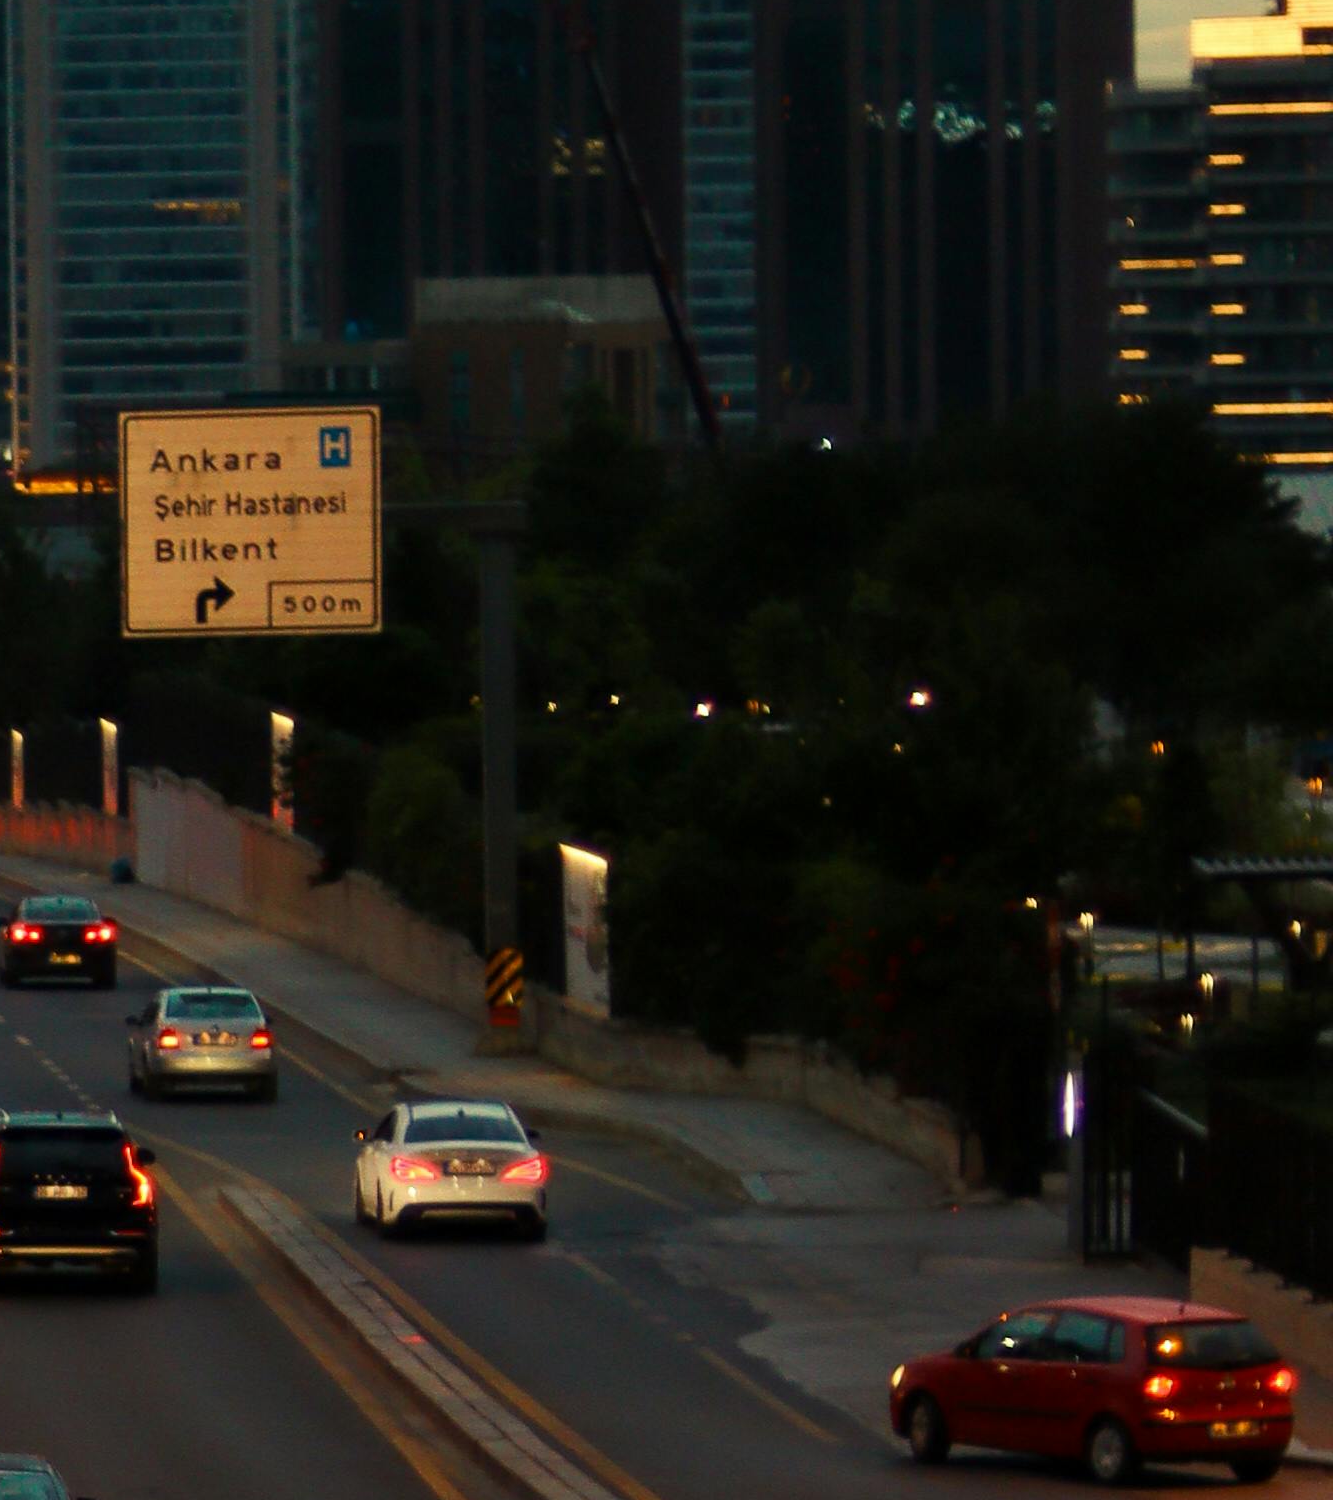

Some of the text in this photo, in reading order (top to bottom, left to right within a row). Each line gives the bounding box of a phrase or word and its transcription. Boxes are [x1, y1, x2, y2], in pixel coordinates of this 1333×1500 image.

[150, 448, 282, 473] Ankara
[155, 491, 347, 521] Şehir Hastanesi
[156, 537, 278, 562] Bilkent
[284, 594, 362, 614] 500m
